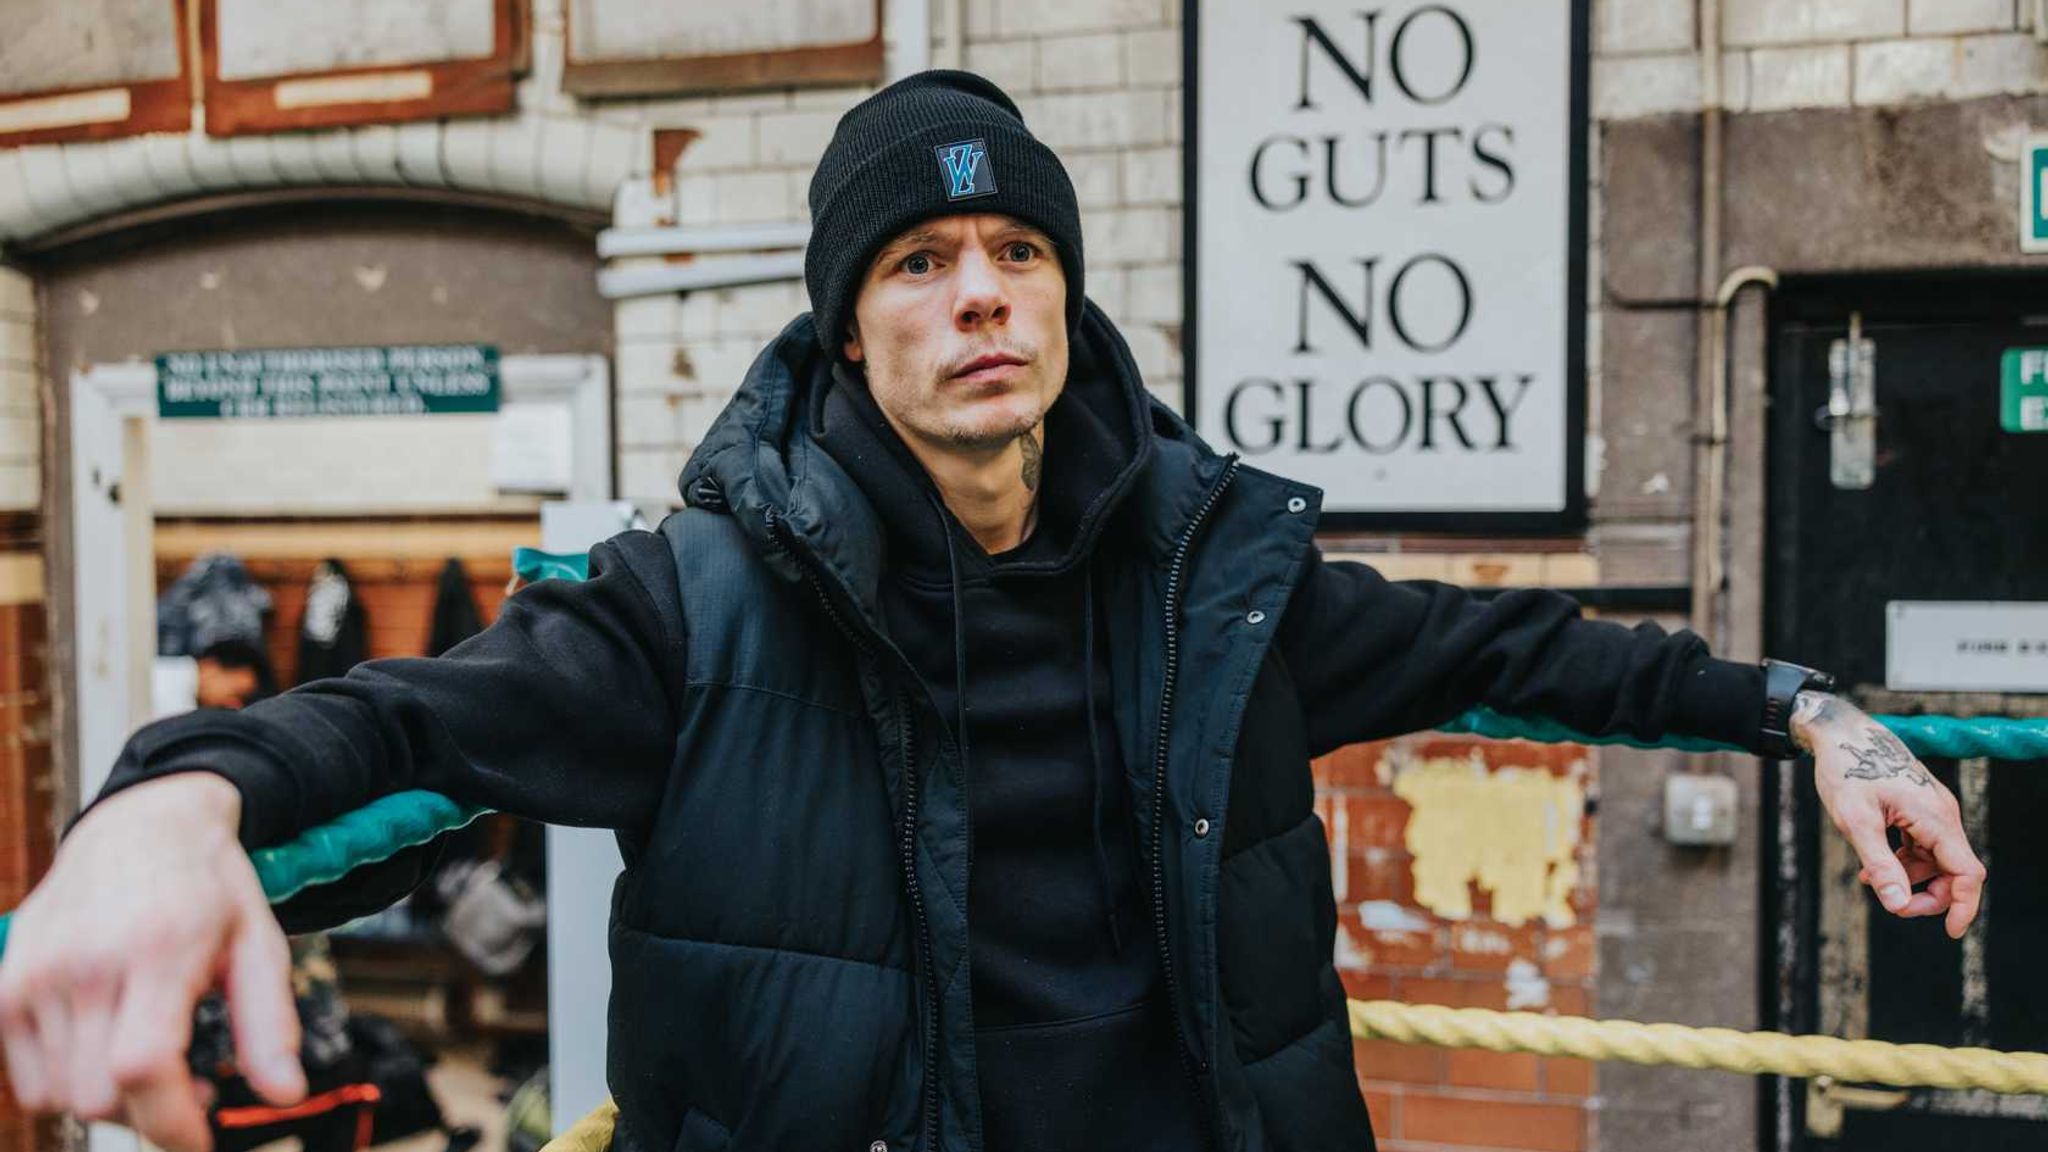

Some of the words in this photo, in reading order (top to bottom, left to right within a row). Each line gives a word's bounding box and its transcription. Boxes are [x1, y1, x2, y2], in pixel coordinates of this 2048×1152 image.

[1290, 4, 1477, 111] NO
[1247, 126, 1515, 211] GUTS
[1290, 253, 1475, 355] NO
[1223, 374, 1534, 455] GLORY
